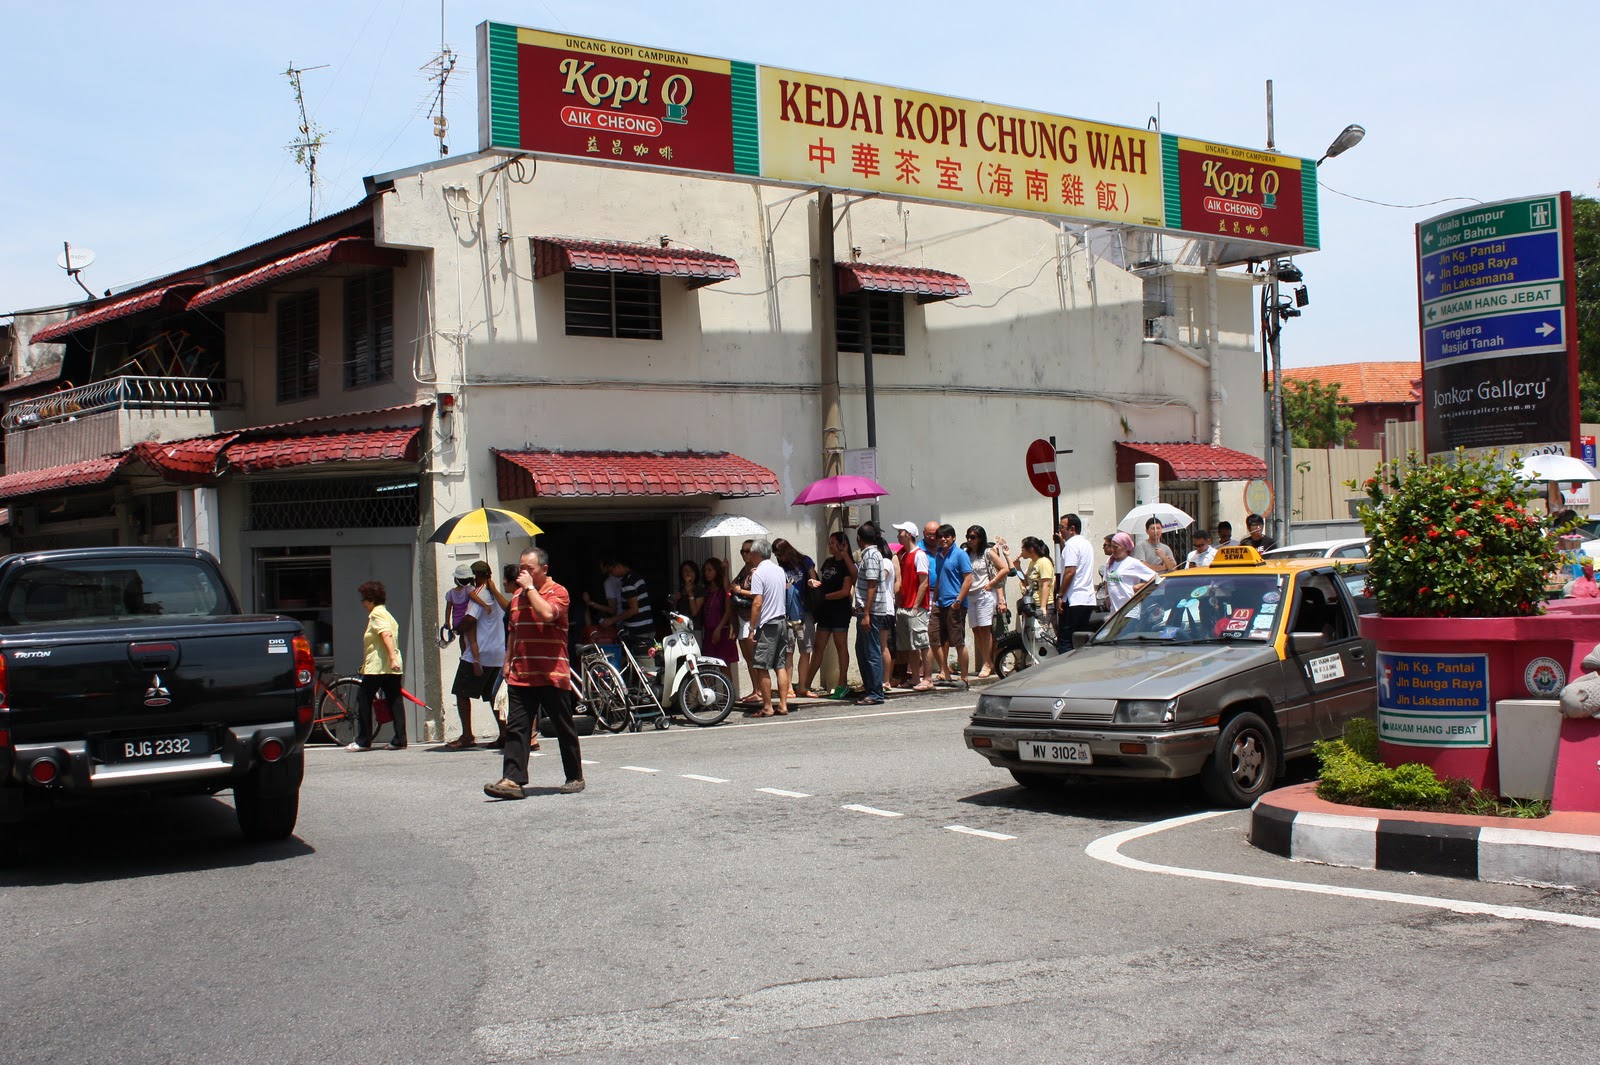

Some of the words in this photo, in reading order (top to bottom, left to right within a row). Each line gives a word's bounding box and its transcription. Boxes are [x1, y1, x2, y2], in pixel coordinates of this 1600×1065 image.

[566, 38, 606, 53] UNCANG
[611, 45, 633, 56] KOPI
[638, 49, 689, 66] CAMPURAN
[559, 58, 651, 109] Kopi
[567, 110, 592, 125] AIK
[597, 113, 657, 133] CHEONG
[778, 79, 884, 135] KEDAI
[894, 98, 968, 148] KOPI
[977, 111, 1078, 164] CHUNG
[1086, 130, 1148, 175] WAH
[586, 136, 673, 160] 益昌咖啡
[1205, 144, 1229, 156] UNCANG
[1231, 149, 1245, 158] KOPI
[1246, 151, 1276, 163] CAMPURAN
[1202, 160, 1255, 198] Kopi
[1207, 199, 1221, 211] AIK
[1224, 202, 1259, 216] CHEONG
[1436, 218, 1460, 233] Kuala
[1462, 209, 1505, 225] Lumpur
[1437, 232, 1461, 247] Johor
[1464, 226, 1496, 240] Bahru
[1438, 252, 1450, 265] Jln
[1452, 250, 1467, 263] Kg.
[1470, 242, 1506, 257] Pantai
[1439, 267, 1451, 280] Jln
[1453, 262, 1485, 276] Bunga
[1488, 256, 1518, 271] Raya
[1440, 281, 1452, 294] Jln
[1453, 271, 1514, 290] Laksamana
[1440, 301, 1472, 316] MAKAM
[1475, 294, 1508, 310] HANG
[1511, 289, 1552, 304] JEBAT
[1441, 325, 1482, 341] Tengkera
[1441, 339, 1469, 355] Masjid
[1471, 335, 1504, 349] Tanah
[1433, 386, 1474, 409] Jonker
[1477, 379, 1546, 400] Gallery
[1439, 403, 1537, 419] www.jonkergallery.com.my
[1220, 547, 1248, 555] KERETA
[14, 650, 51, 659] TRITON
[1396, 661, 1409, 672] Jln
[1413, 662, 1432, 675] Kg.
[1437, 662, 1475, 673] Pantai
[1396, 677, 1409, 688] Jln
[1412, 678, 1448, 691] Bunga
[1452, 678, 1483, 692] Raya
[1397, 694, 1410, 705] Jln
[1412, 695, 1479, 707] Laksamana
[1389, 722, 1414, 733] MAKAM
[1416, 724, 1443, 735] HANG
[1445, 725, 1477, 735] JEBAT
[124, 740, 152, 758] BJG
[156, 738, 191, 756] 2332
[1032, 743, 1047, 758] MV
[1052, 744, 1077, 760] 3102
